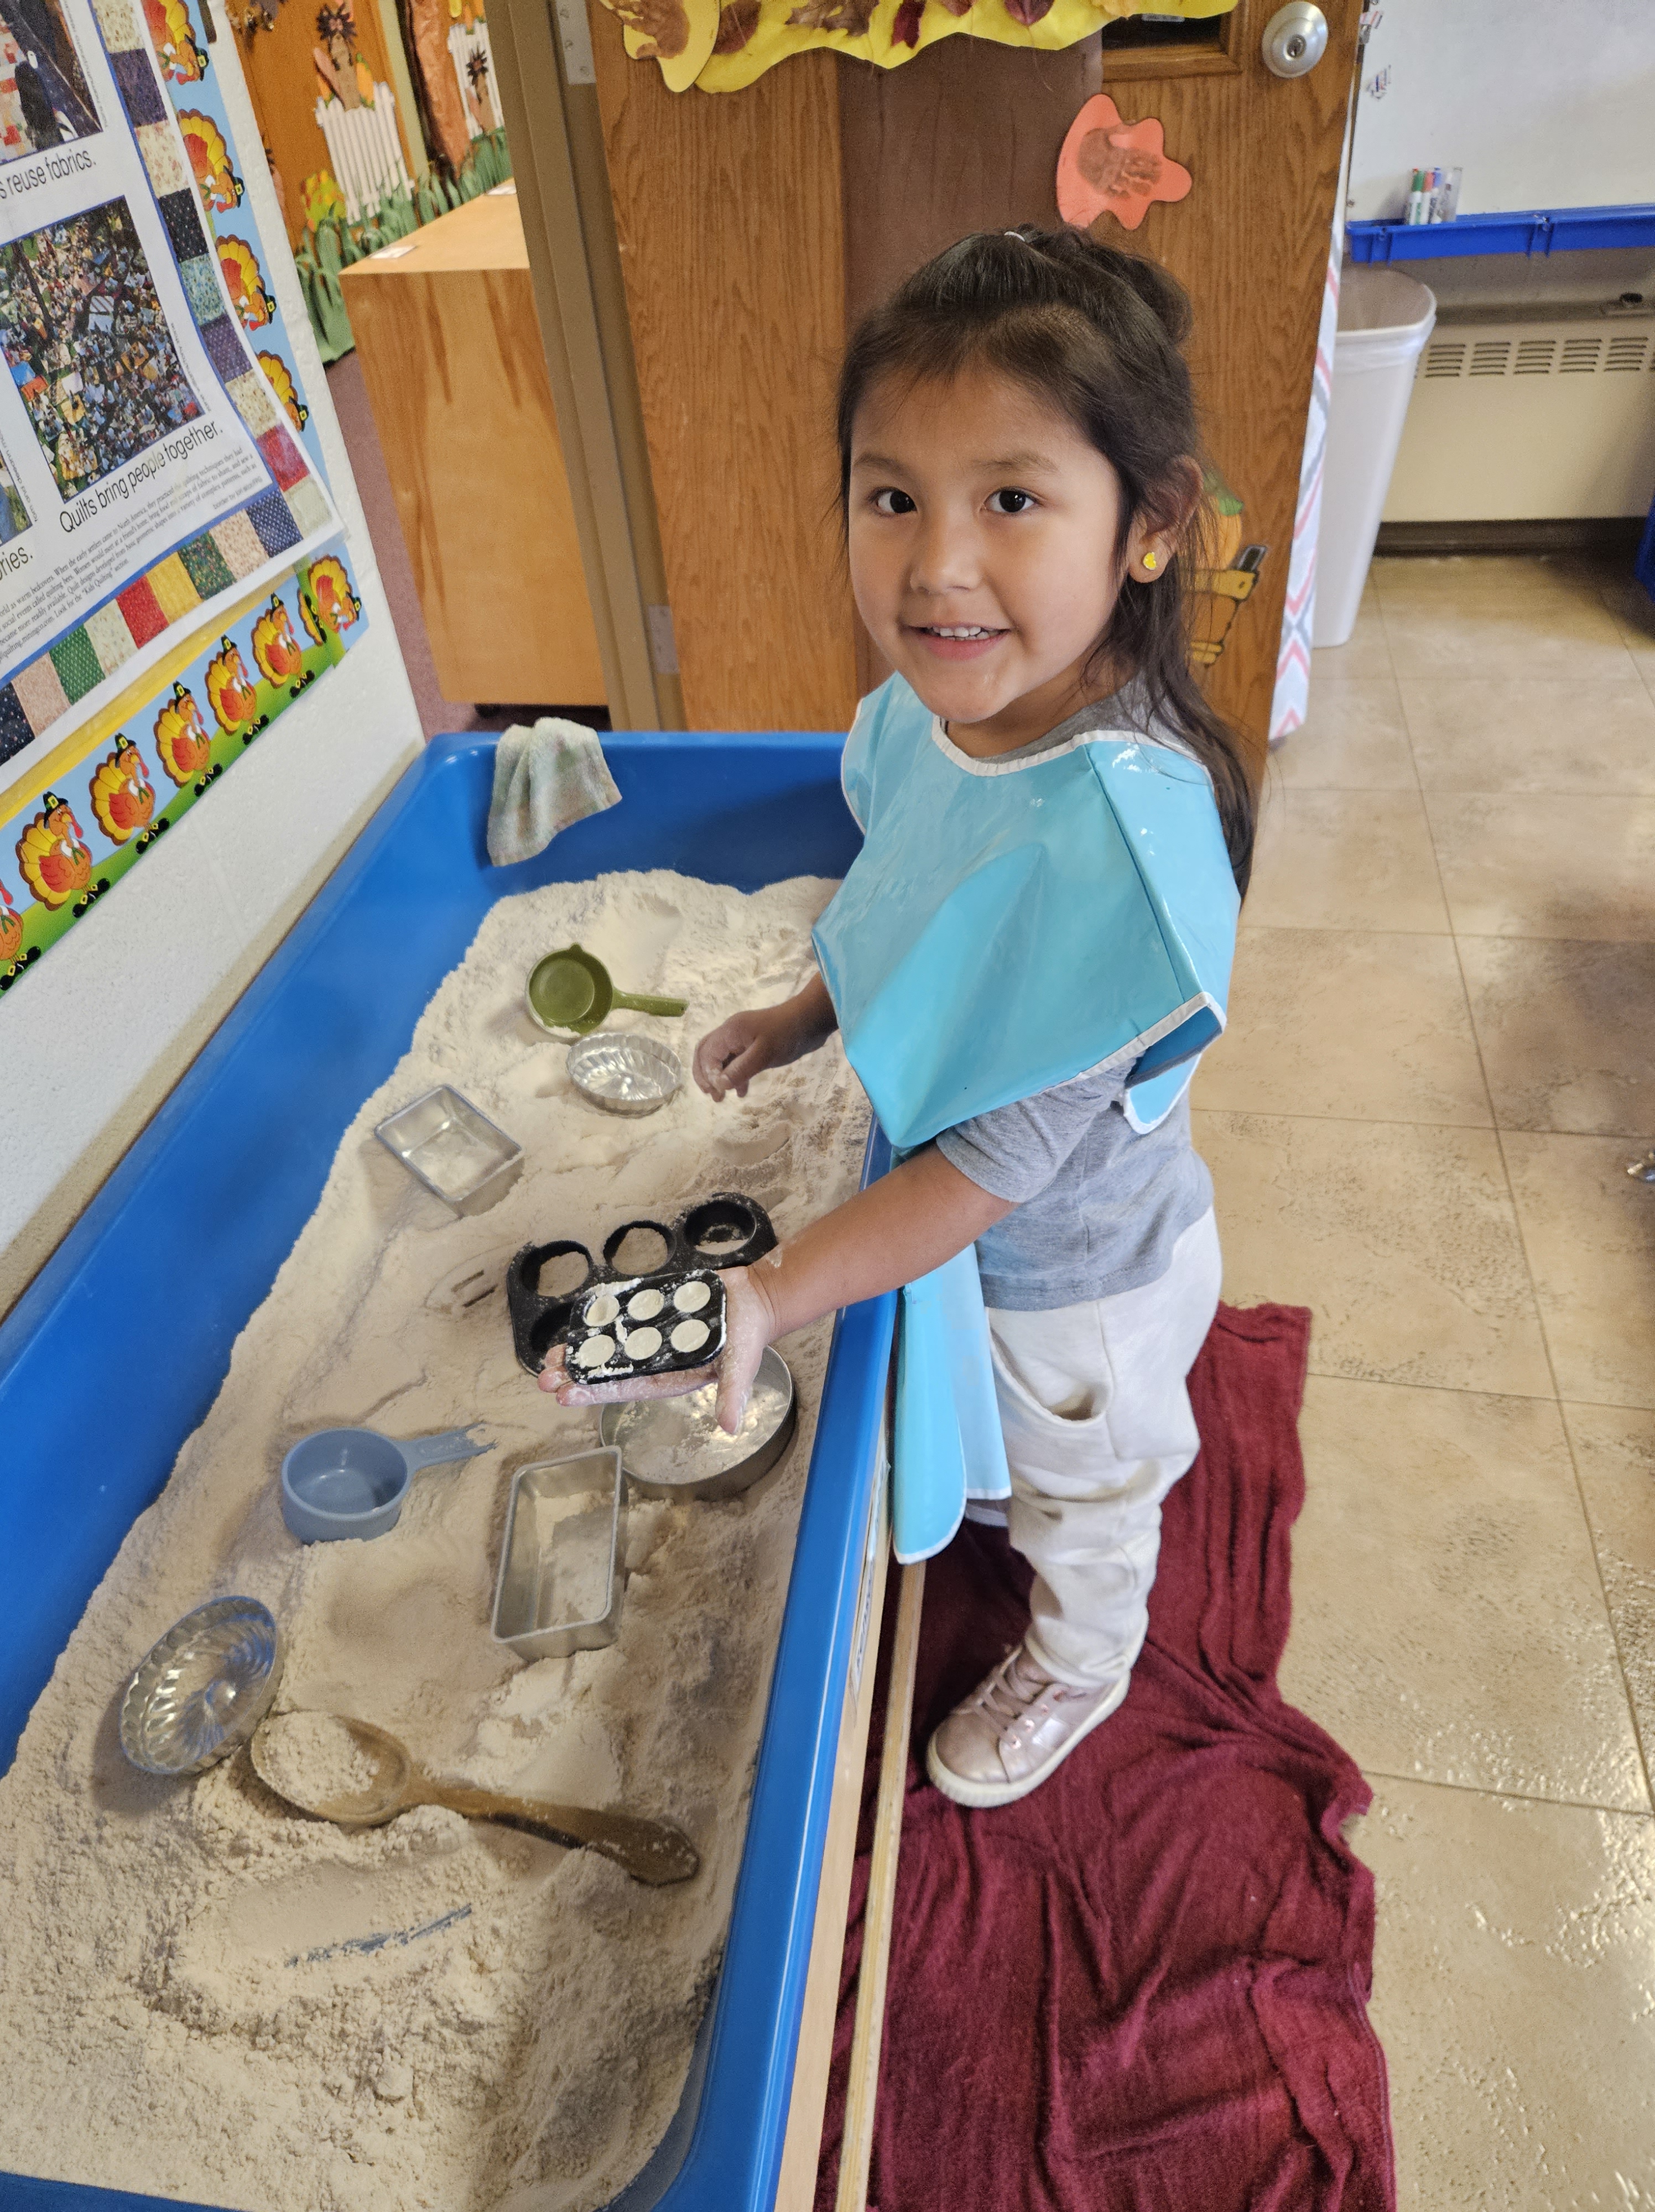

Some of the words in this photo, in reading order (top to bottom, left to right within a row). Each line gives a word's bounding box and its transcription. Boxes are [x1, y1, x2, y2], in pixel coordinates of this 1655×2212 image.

[7, 168, 47, 195] reuse
[45, 148, 97, 181] fabrics.
[60, 498, 98, 533] Quilts
[95, 477, 129, 509] bring
[127, 452, 166, 493] people
[163, 420, 223, 462] together.
